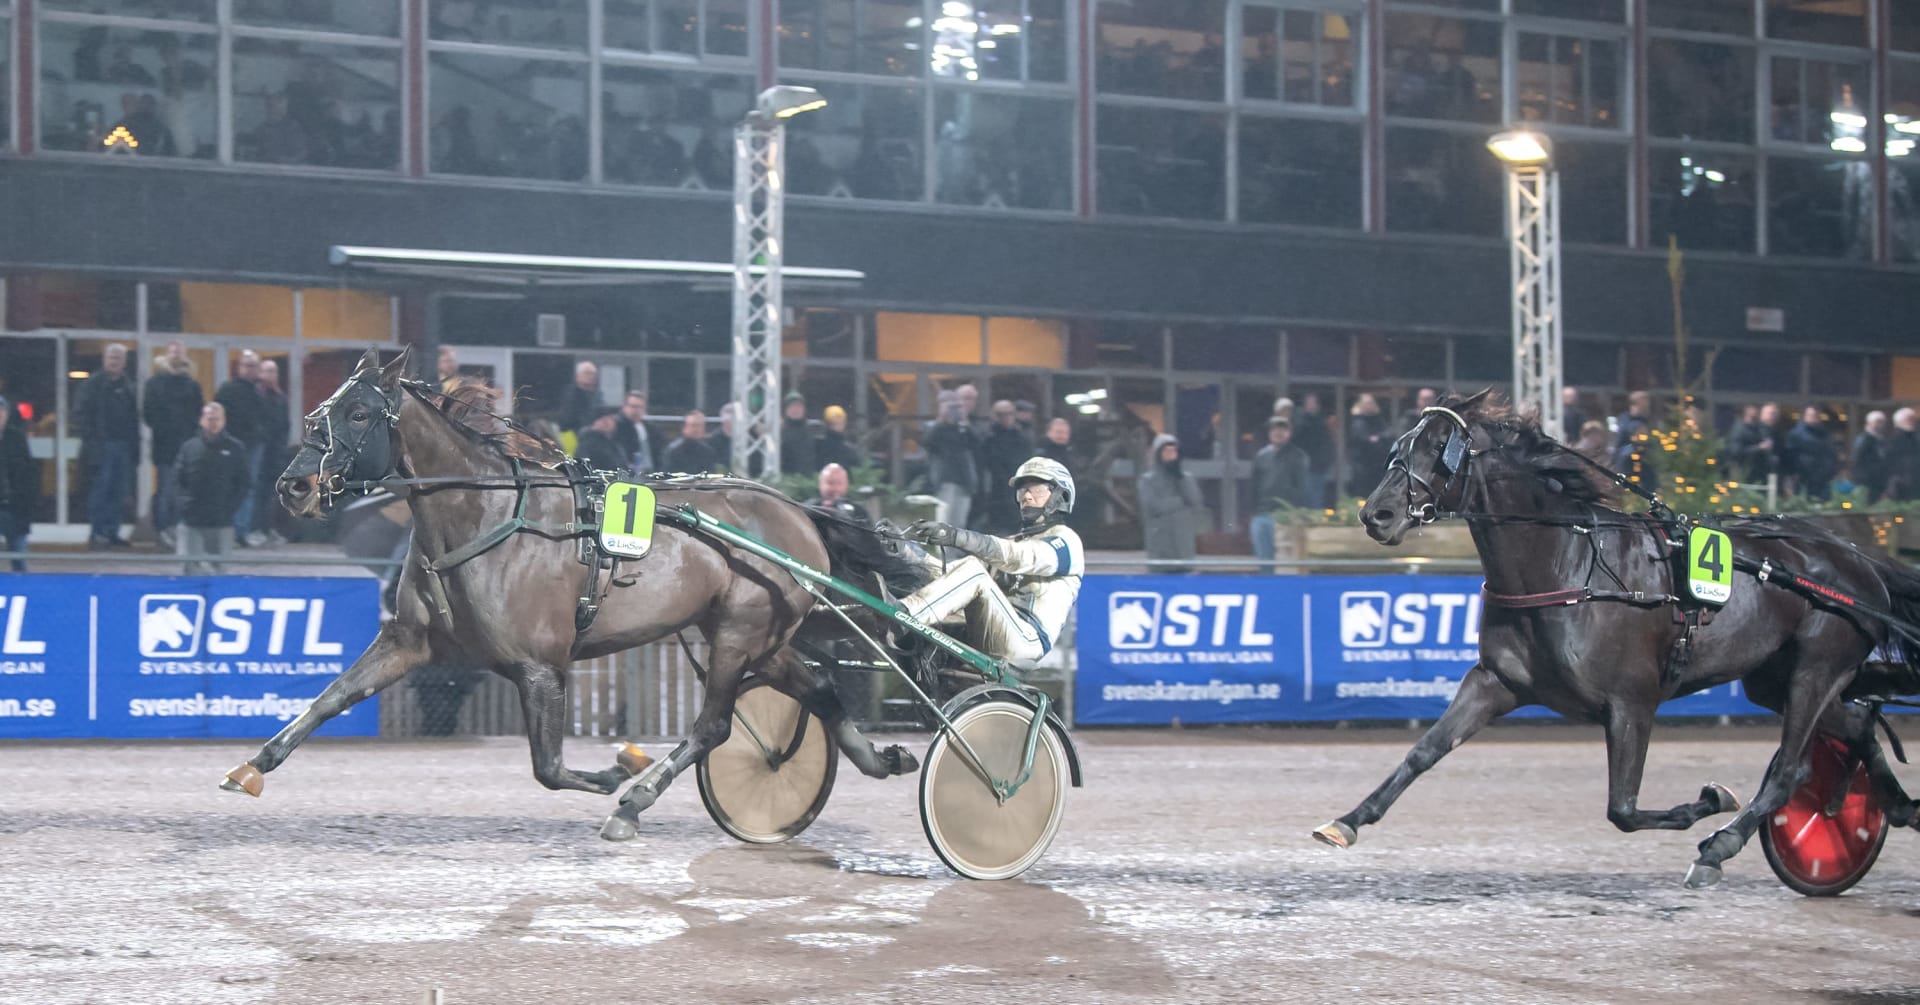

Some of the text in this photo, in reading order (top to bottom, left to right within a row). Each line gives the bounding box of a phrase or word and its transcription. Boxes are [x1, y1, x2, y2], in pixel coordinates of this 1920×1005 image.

[622, 487, 638, 534] 1
[1698, 533, 1724, 582] 4
[206, 598, 343, 655] STL
[1161, 594, 1273, 647] STL
[1391, 593, 1480, 645] STL
[139, 661, 343, 675] SVENSKA TRAVLIGAN
[1110, 651, 1274, 664] SVENSKA TRAVLIGAN
[1342, 649, 1480, 662] SVENSKA TRAVLIG
[1103, 679, 1281, 704] svenskatravligan.se
